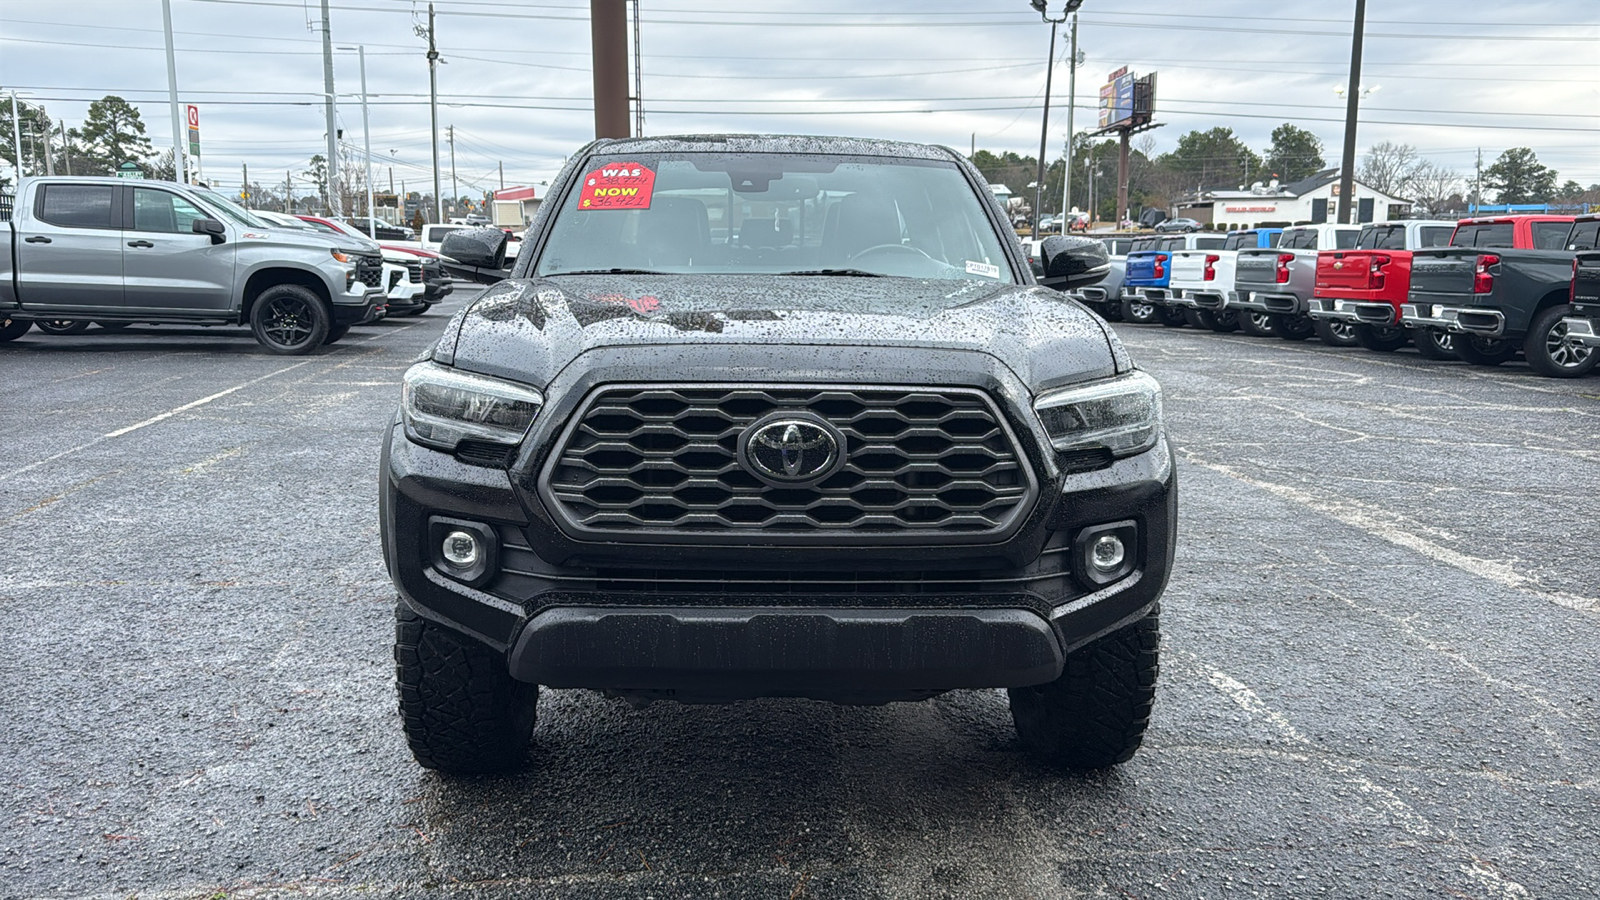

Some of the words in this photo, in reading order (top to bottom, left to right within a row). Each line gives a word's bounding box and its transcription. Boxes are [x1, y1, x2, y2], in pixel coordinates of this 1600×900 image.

[602, 169, 641, 177] WAS
[588, 178, 596, 186] $
[594, 187, 639, 197] NOW
[583, 199, 591, 207] $
